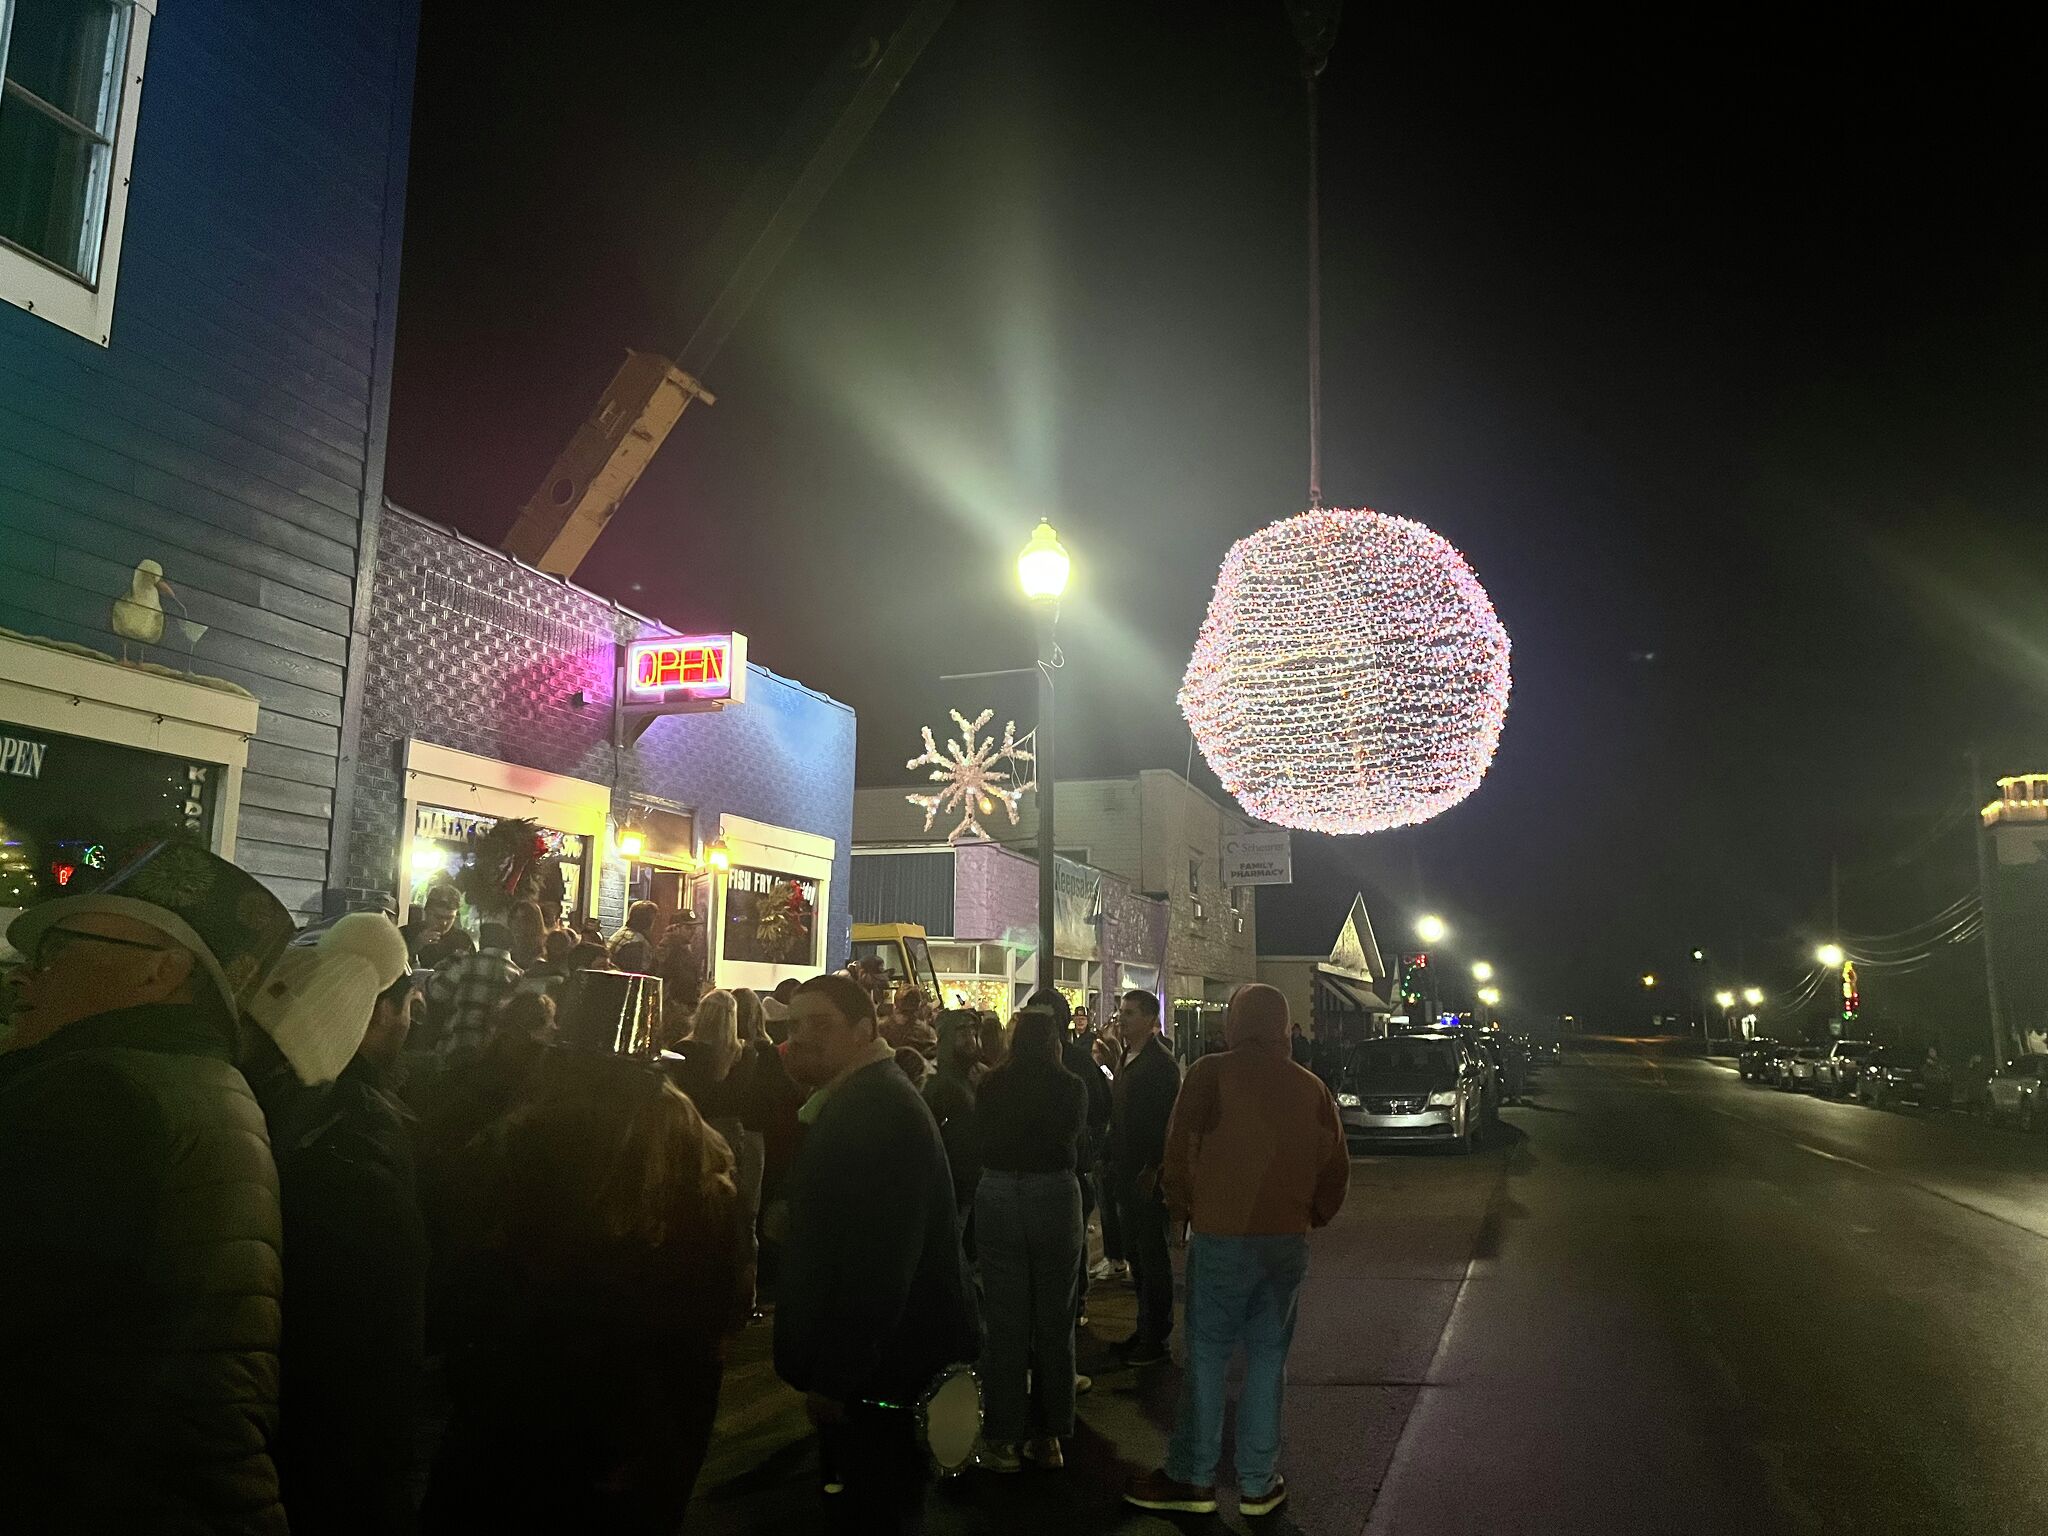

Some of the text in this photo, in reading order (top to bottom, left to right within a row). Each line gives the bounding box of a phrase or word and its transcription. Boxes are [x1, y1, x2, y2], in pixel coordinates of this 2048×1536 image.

[636, 646, 728, 688] OPEN
[0, 737, 47, 780] PEN
[416, 810, 475, 843] DAILY
[1231, 869, 1284, 878] PHARMACY
[1240, 862, 1274, 870] FAMILY
[728, 868, 752, 892] FISH
[754, 872, 773, 895] FRY
